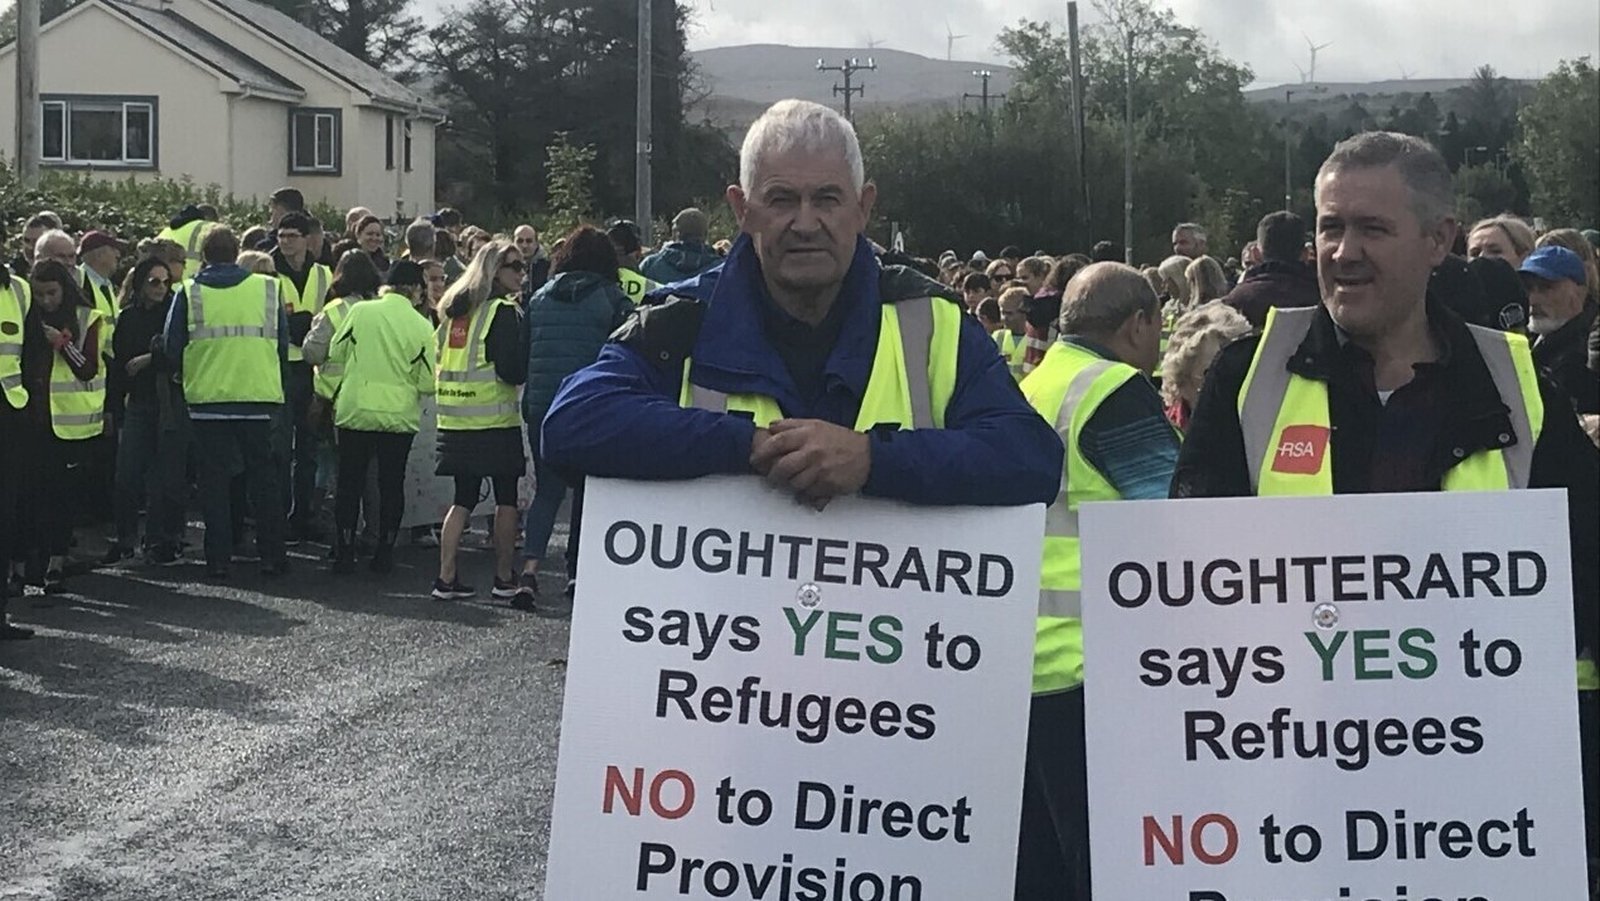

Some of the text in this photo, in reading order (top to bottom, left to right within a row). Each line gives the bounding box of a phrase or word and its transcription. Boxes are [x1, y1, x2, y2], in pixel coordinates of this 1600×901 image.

[1279, 441, 1315, 457] RSA
[604, 520, 1014, 598] OUGHTERARD
[1108, 550, 1548, 609] OUGHTERARD
[622, 606, 981, 672] says YES to
[1139, 627, 1522, 699] says YES to
[655, 668, 936, 744] Refugees
[1184, 707, 1484, 772] Refugees
[602, 765, 972, 844] NO to Direct
[1142, 807, 1537, 866] NO to Direct
[636, 841, 922, 901] Provision
